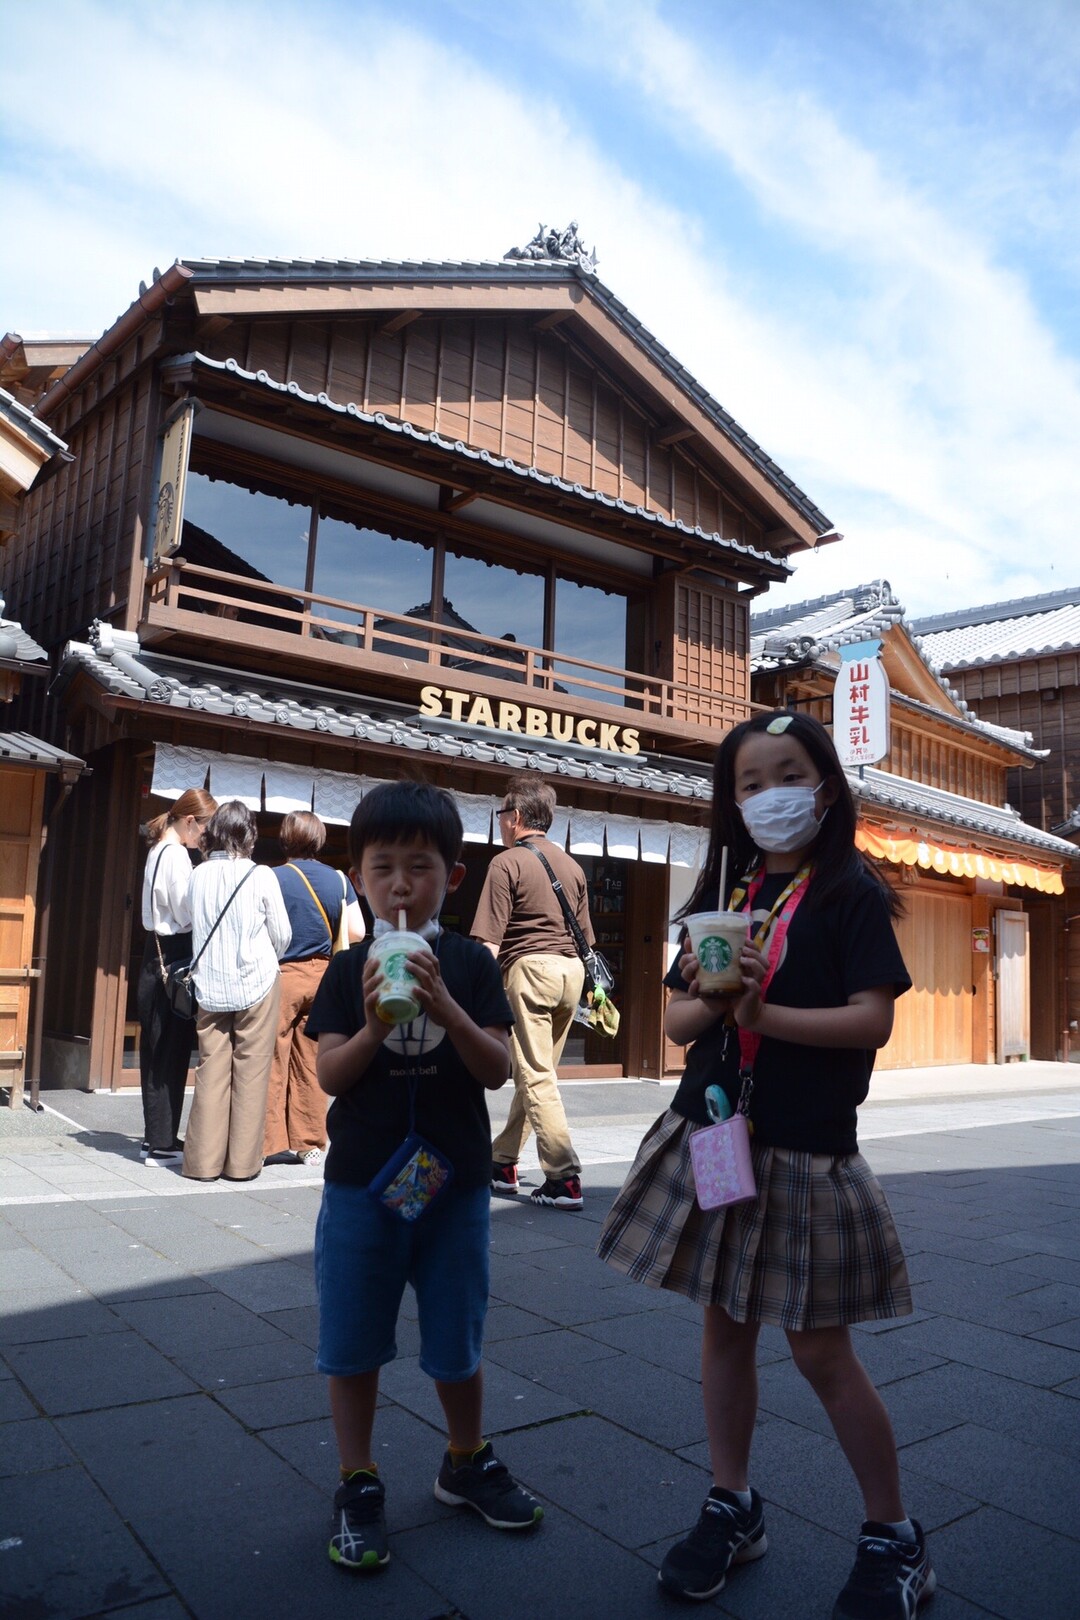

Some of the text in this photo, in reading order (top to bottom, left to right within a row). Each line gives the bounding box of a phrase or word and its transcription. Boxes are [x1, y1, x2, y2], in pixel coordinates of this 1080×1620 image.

[418, 685, 640, 756] STARBUCKS
[849, 663, 870, 746] 山村牛乳
